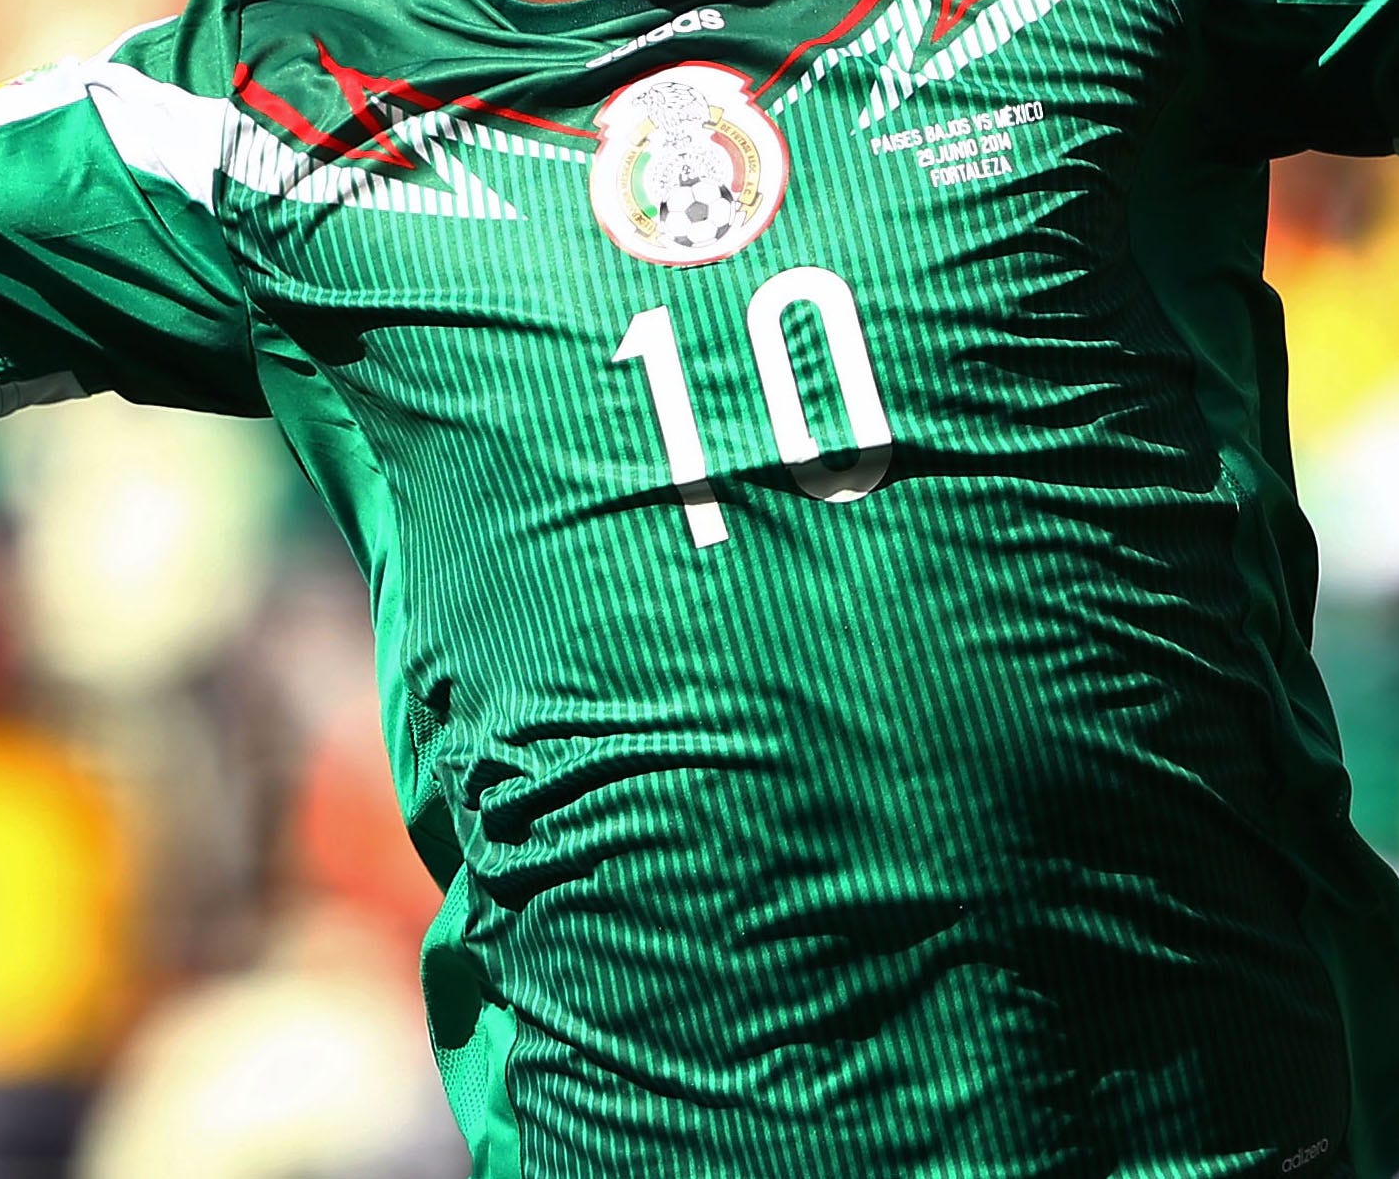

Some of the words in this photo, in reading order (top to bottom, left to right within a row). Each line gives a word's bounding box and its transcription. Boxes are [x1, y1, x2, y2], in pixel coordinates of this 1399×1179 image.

[870, 129, 923, 156] PAISES
[924, 117, 972, 145] BAJOS
[972, 112, 993, 132] VS
[932, 138, 978, 164] JUNIO
[979, 132, 1012, 154] 2014
[930, 156, 1013, 187] FORTALEZA
[611, 266, 893, 548] 10
[1282, 1138, 1329, 1173] adizero
